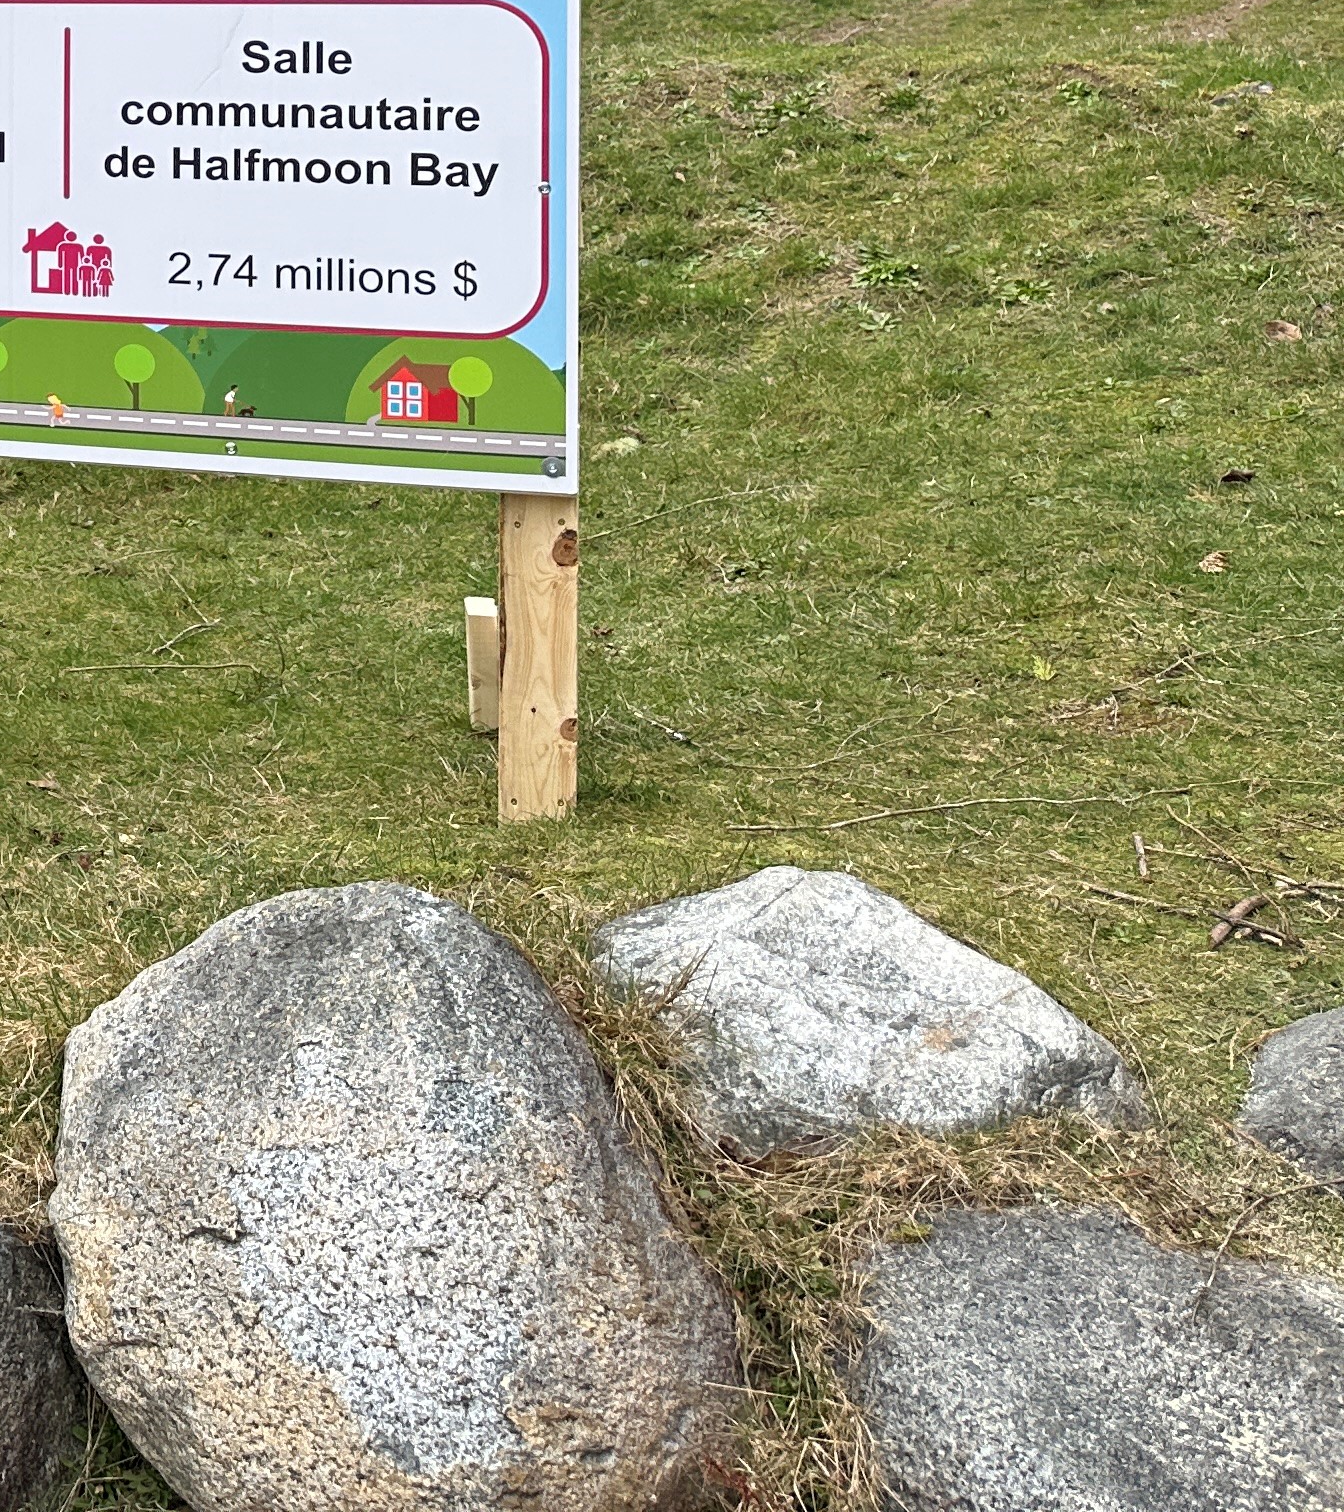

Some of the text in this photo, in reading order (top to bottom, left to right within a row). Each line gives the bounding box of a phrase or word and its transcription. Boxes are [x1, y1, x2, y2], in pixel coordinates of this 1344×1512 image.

[241, 39, 353, 75] Salle
[120, 96, 481, 133] communautaire
[104, 145, 500, 198] de Halfmoon Bay
[167, 251, 478, 301] 2,74 millions $
